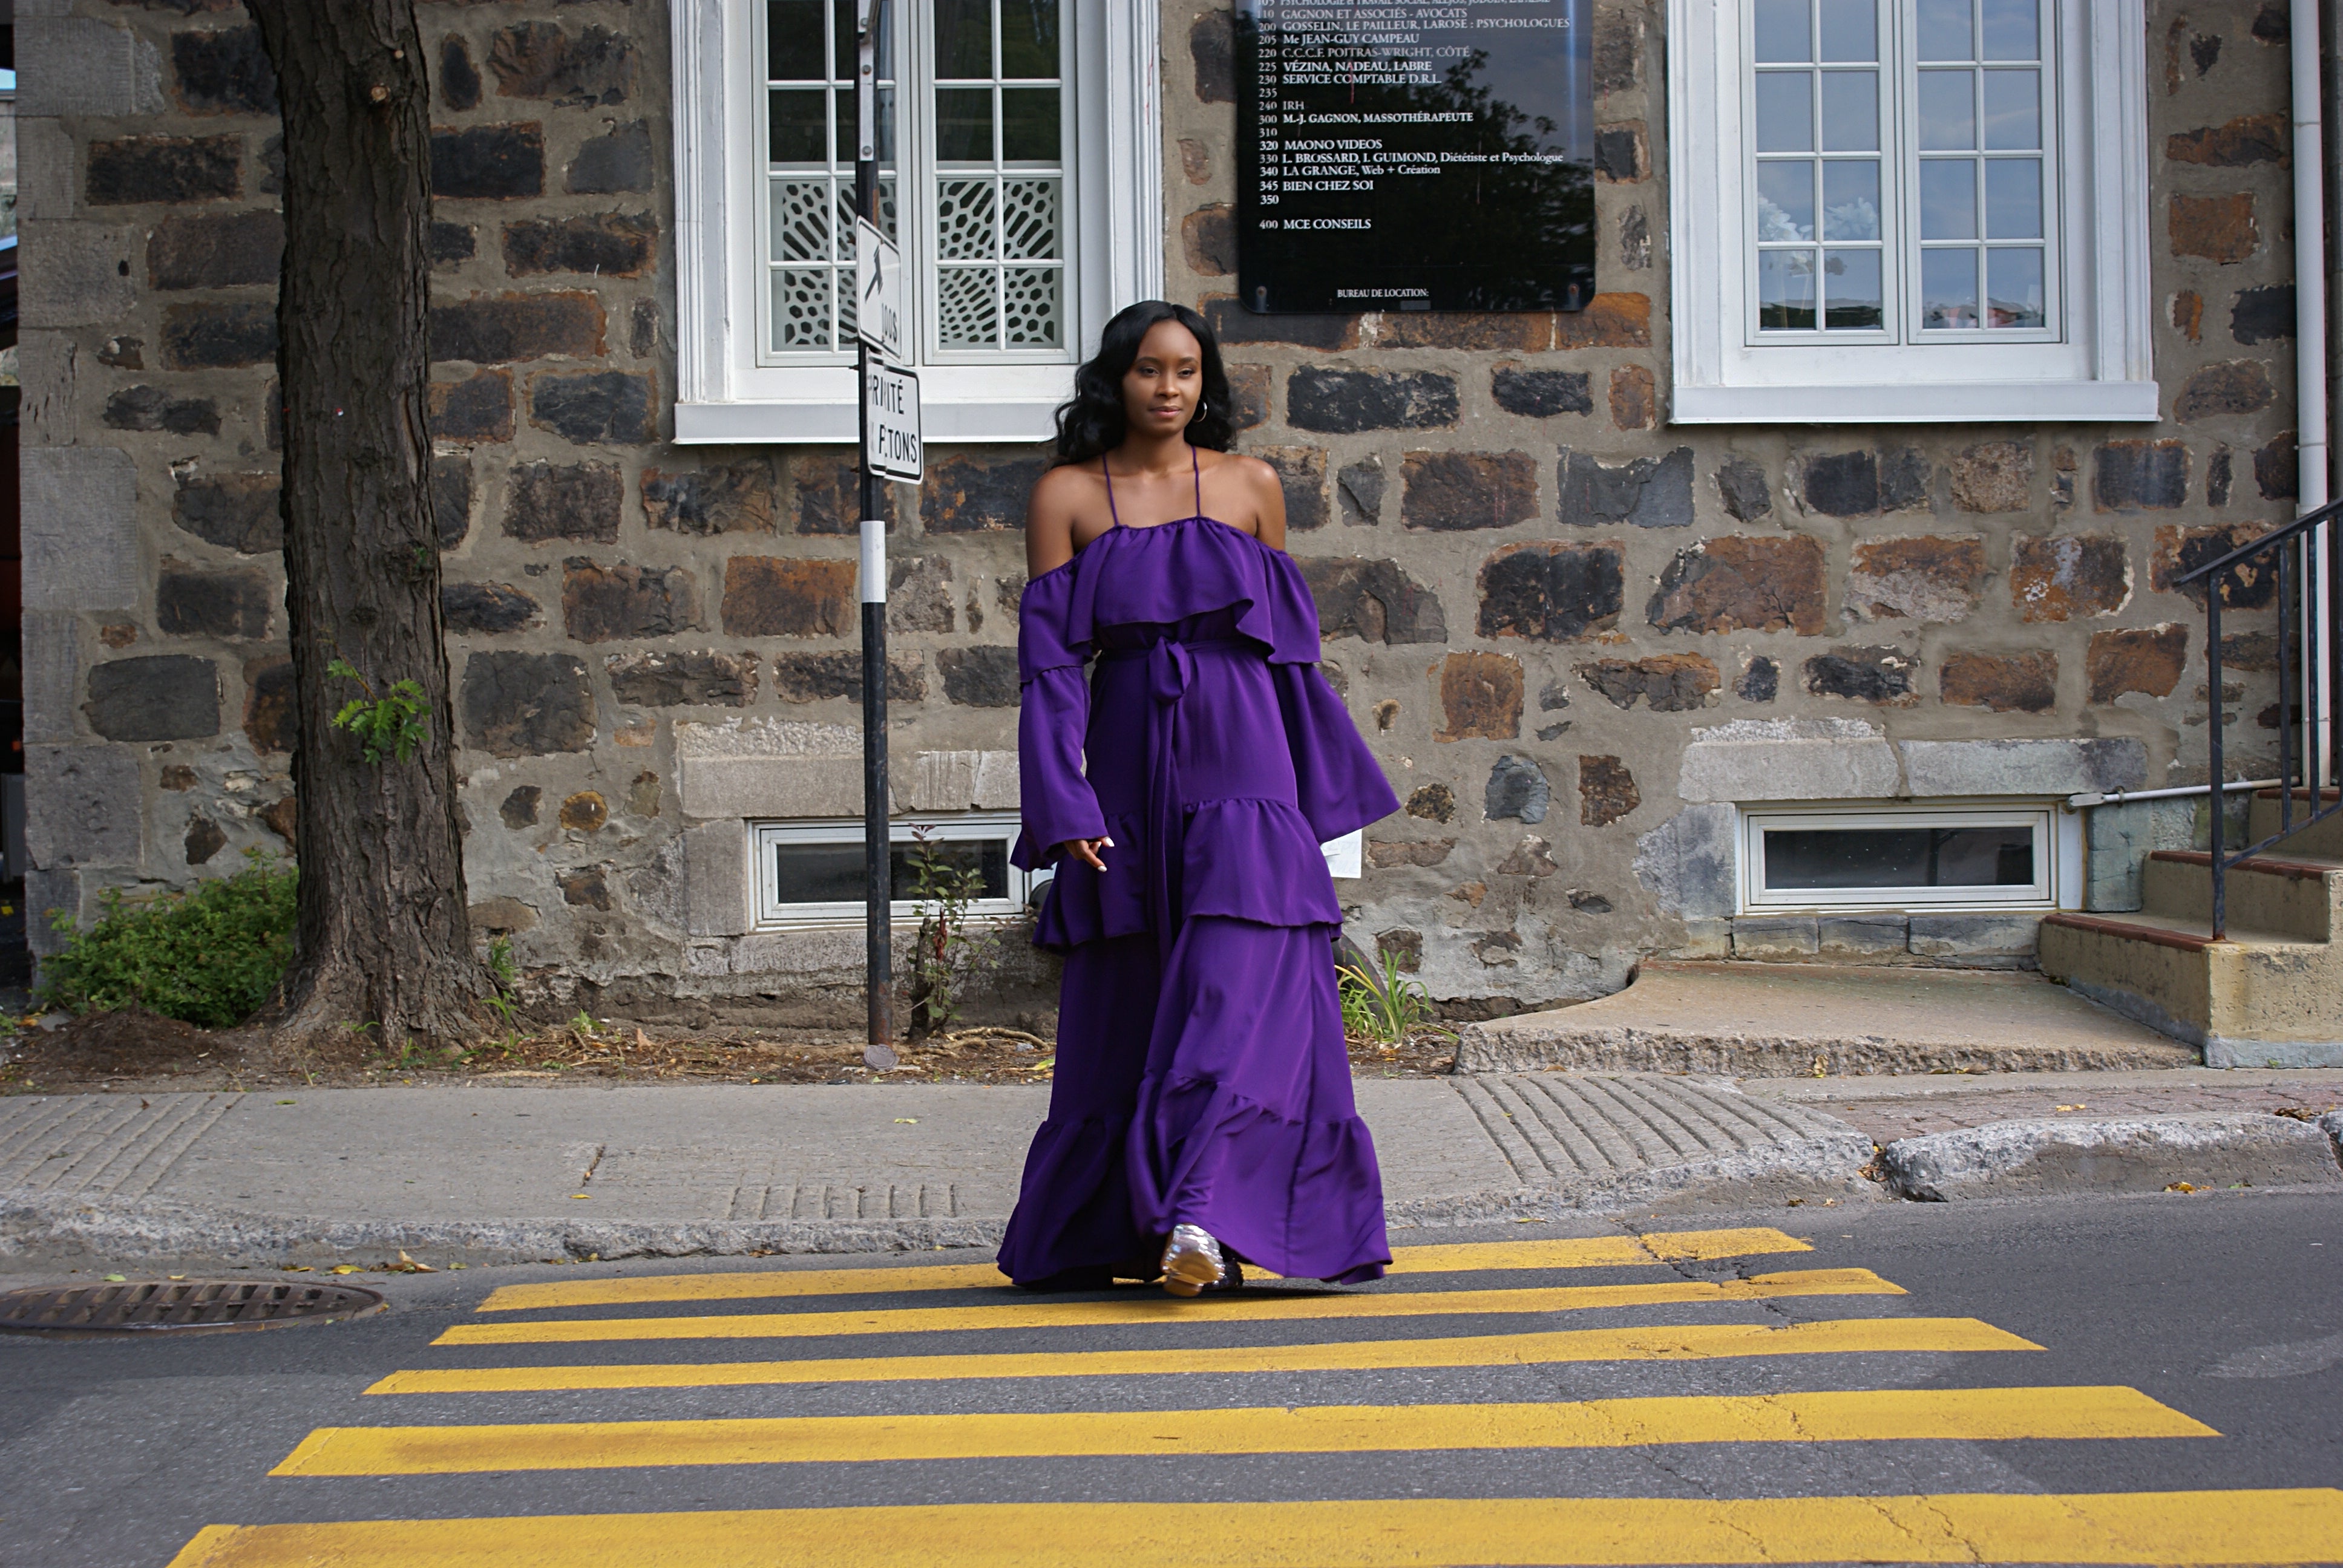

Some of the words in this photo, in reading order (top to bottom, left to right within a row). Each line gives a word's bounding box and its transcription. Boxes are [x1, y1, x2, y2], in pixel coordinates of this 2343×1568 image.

[1258, 10, 1274, 19] 110
[1281, 9, 1333, 19] GAGNON
[1337, 9, 1351, 19] ET
[1354, 7, 1407, 19] ASSOCIÉS
[1415, 8, 1467, 18] AVOCATS
[1259, 22, 1276, 31] 200
[1282, 21, 1343, 31] GOSSELIN,
[1346, 21, 1360, 30] LE
[1363, 20, 1421, 30] PAILLEUR,
[1424, 19, 1467, 28] LAROSE
[1476, 18, 1570, 28] PSYCHOLOGUES
[1259, 35, 1276, 45] 205
[1283, 34, 1300, 44] Me
[1301, 33, 1359, 46] JEAN-GUY
[1362, 33, 1420, 44] CAMPEAU
[1258, 48, 1277, 57] 220
[1328, 47, 1434, 57] POITRAS-WRIGHT,
[1436, 45, 1470, 57] CÔTÉ
[1259, 62, 1276, 72] 225
[1283, 59, 1333, 72] VÉZINA,
[1335, 61, 1392, 72] NADEAU,
[1394, 61, 1432, 71] LABRE
[1258, 75, 1277, 84] 230
[1282, 74, 1331, 84] SERVICE
[1333, 74, 1406, 83] COMPTABLE
[1409, 74, 1442, 83] D.R.L.
[1259, 88, 1277, 98] 235
[1259, 101, 1277, 111] 240
[1283, 100, 1305, 110] IRH
[1259, 115, 1277, 125] 300
[1308, 113, 1362, 123] GAGNON,
[1363, 111, 1474, 123] MASSOTHÉRAPEUTE
[1259, 128, 1278, 138] 310
[1259, 141, 1279, 151] 320
[1284, 140, 1335, 150] MAONO
[1336, 139, 1383, 149] VIDEOS
[1259, 154, 1279, 164] 330
[1282, 154, 1293, 163] L.
[1296, 152, 1361, 165] BROSSARD,
[1373, 152, 1438, 164] GUIMOND,
[1441, 152, 1487, 162] Diététiste
[1502, 152, 1564, 165] Psychologue
[1259, 166, 1279, 177] 340
[1283, 166, 1299, 176] LA
[1302, 165, 1360, 177] GRANGE,
[1362, 165, 1384, 175] Web
[1398, 164, 1441, 175] Création
[1259, 181, 1279, 191] 345
[1282, 181, 1313, 191] BIEN
[1314, 180, 1351, 191] CHEZ
[1352, 180, 1374, 190] SOI
[1260, 195, 1279, 205] 350
[1259, 220, 1279, 229] 400
[1283, 219, 1311, 229] MCE
[1312, 218, 1372, 229] CONSEILS
[1337, 289, 1370, 298] BUREAU
[1371, 289, 1383, 297] DE
